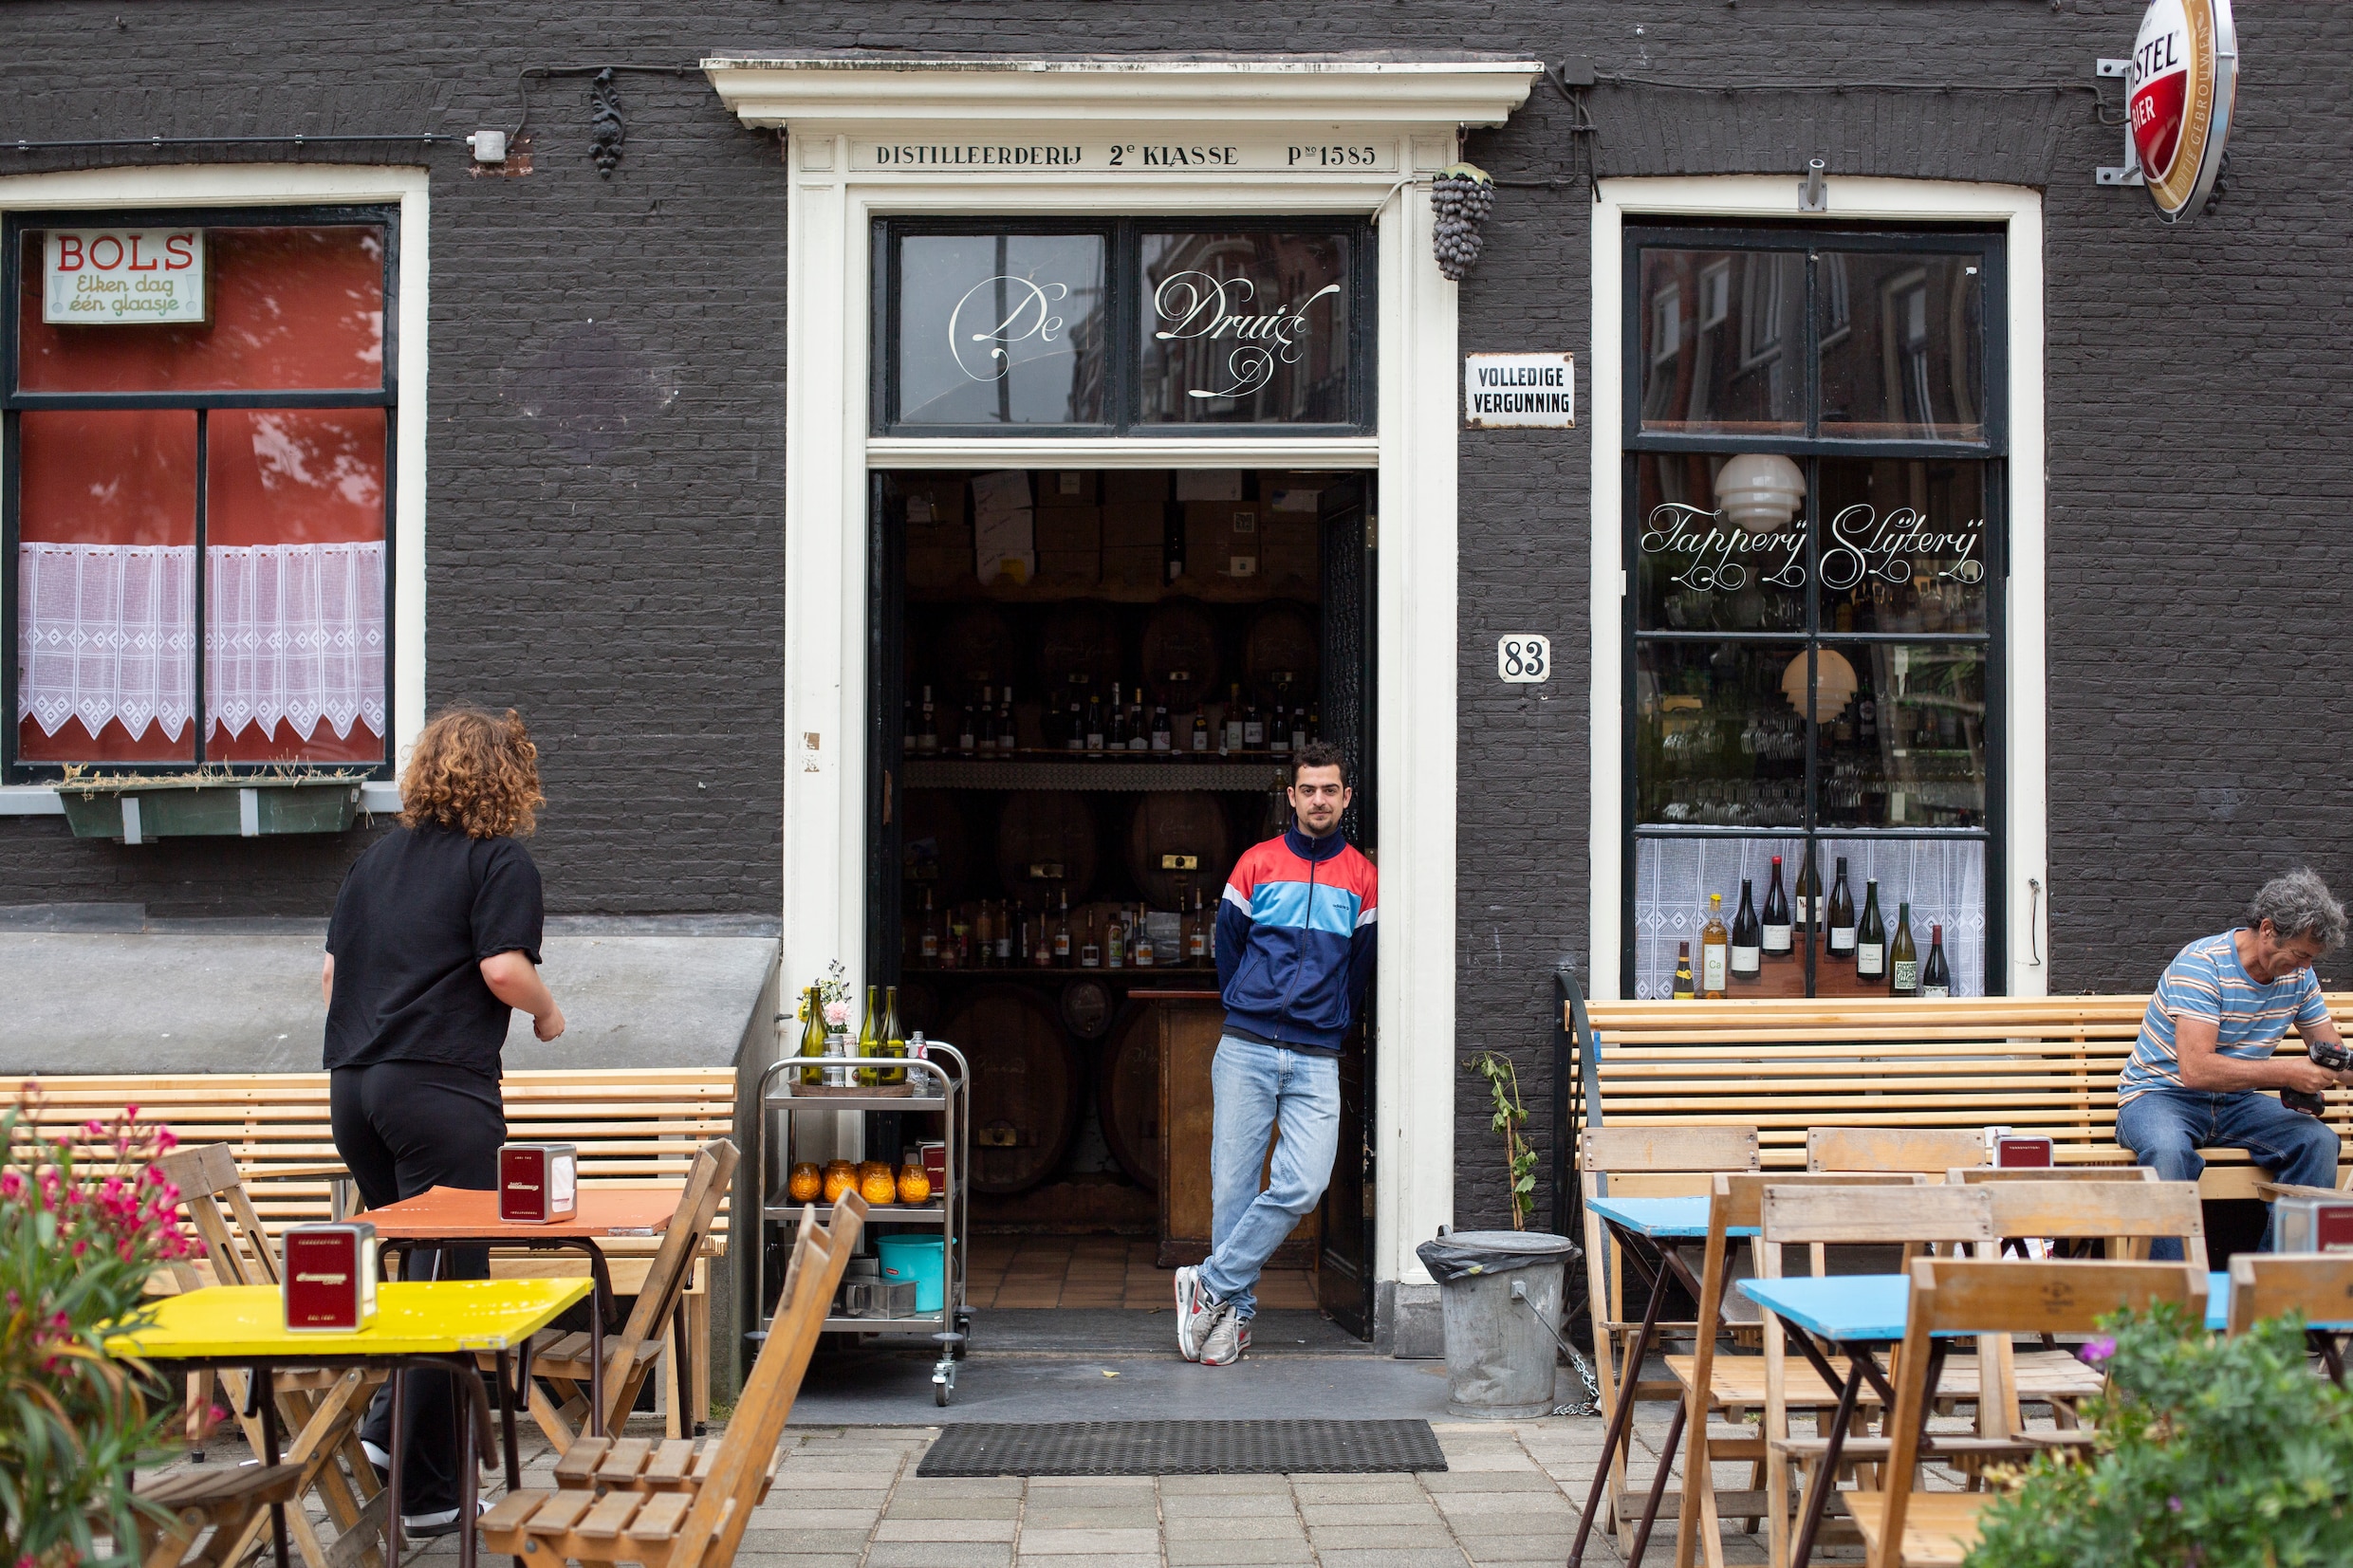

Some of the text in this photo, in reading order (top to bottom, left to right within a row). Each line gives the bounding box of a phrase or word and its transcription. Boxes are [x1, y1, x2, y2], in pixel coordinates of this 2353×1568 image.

[2131, 32, 2178, 88] STEL
[2191, 26, 2211, 145] GEBROUWEN
[2132, 95, 2157, 133] BIER
[876, 146, 1083, 165] DISTILLEERDERIJ
[1142, 145, 1239, 167] KLASSE
[57, 233, 194, 271] BOLS
[77, 274, 174, 297] Elken dag
[69, 294, 180, 317] één glaasje
[949, 270, 1340, 398] De Druif
[1478, 367, 1564, 387] VOLLEDIGE
[1473, 393, 1569, 413] VERGUNNING
[1505, 640, 1545, 676] 83
[1709, 959, 1721, 969] Ca
